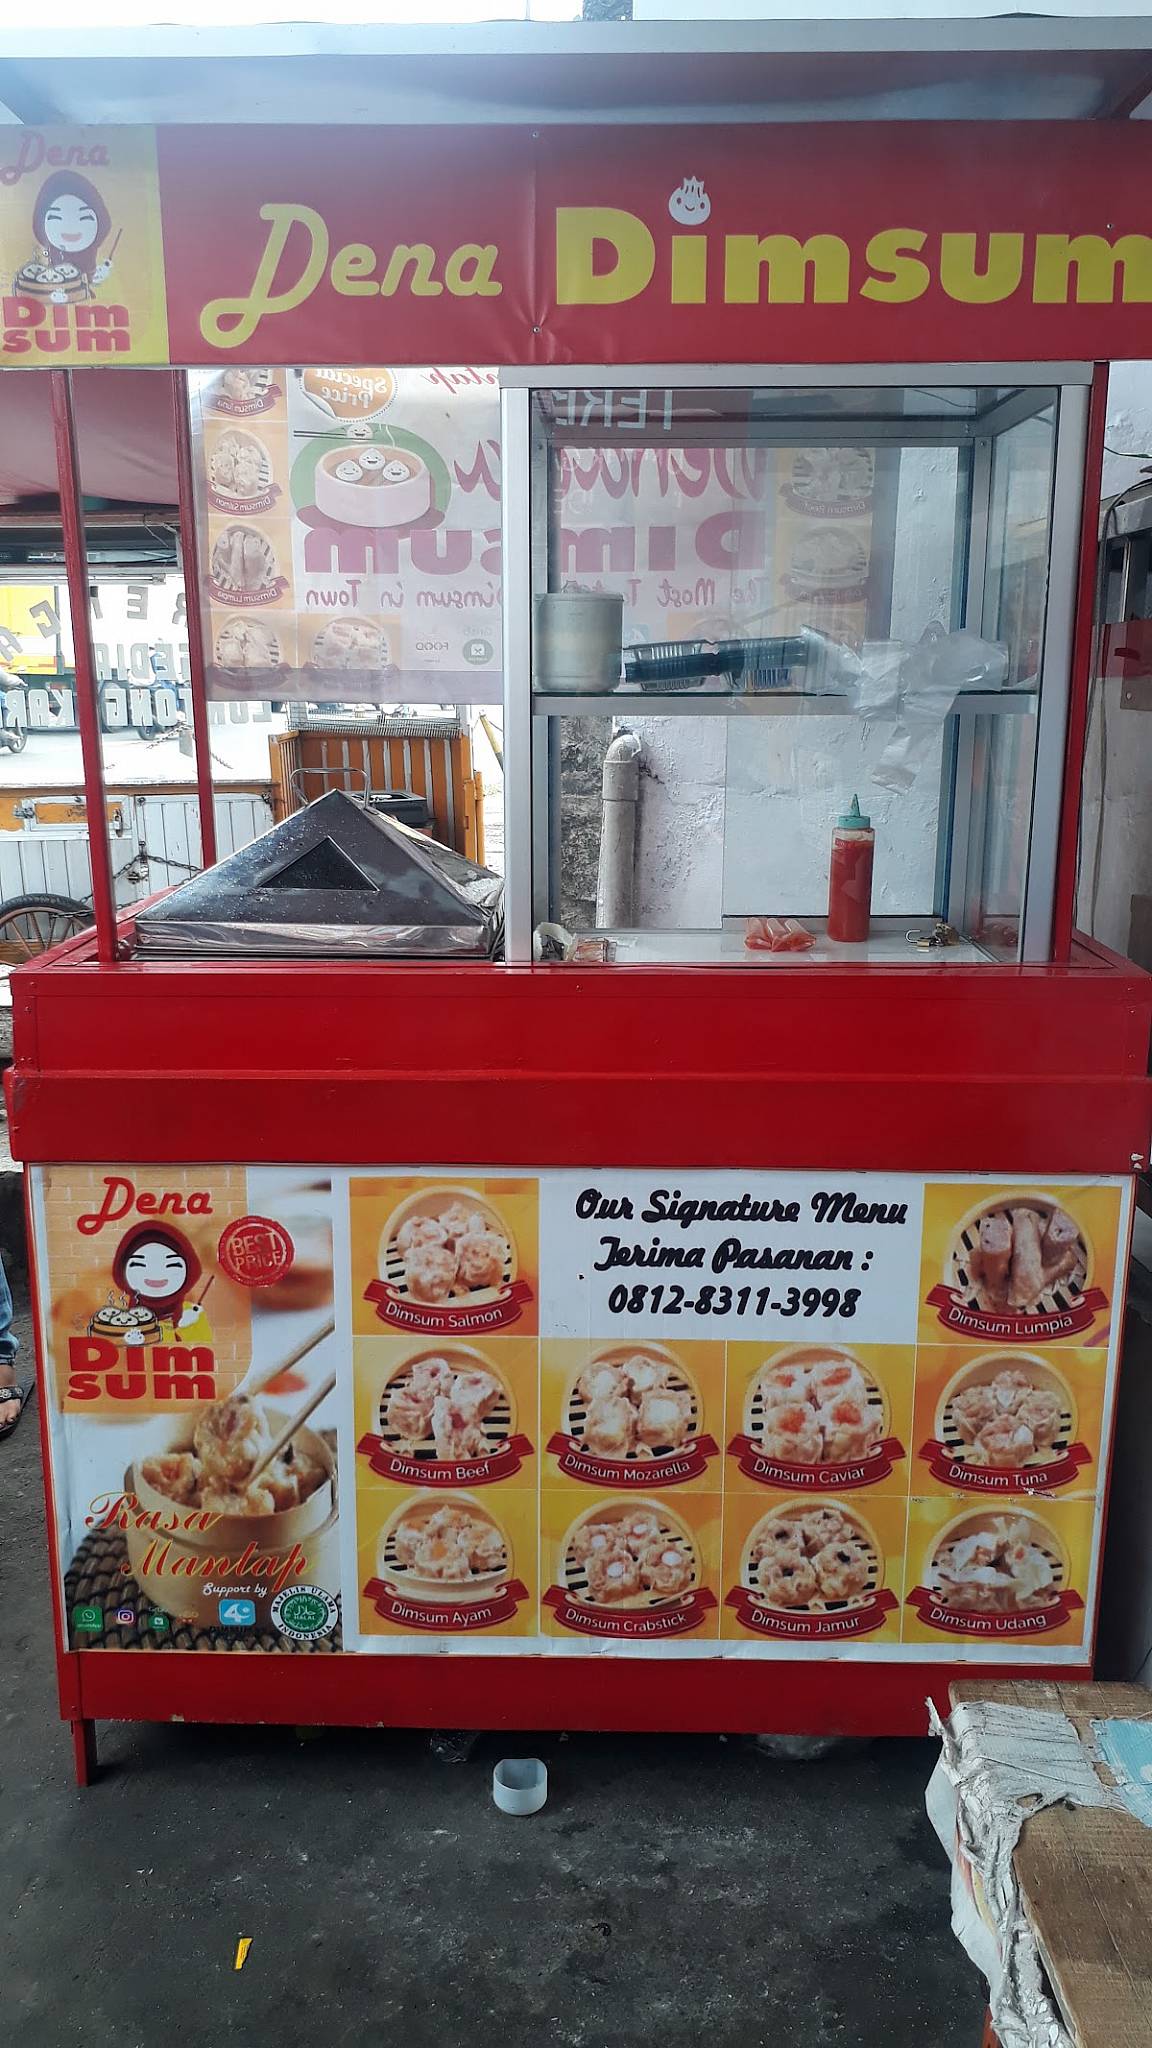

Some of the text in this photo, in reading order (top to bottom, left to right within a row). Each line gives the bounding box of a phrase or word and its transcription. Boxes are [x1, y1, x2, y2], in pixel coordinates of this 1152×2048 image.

[0, 131, 110, 186] Dena
[199, 203, 1152, 349] Dena Dimsum
[2, 298, 131, 327] Dim
[2, 328, 131, 353] sum
[77, 1177, 213, 1235] Dena
[575, 1188, 908, 1228] Our Signature Menu
[231, 1231, 277, 1257] BEST
[594, 1236, 706, 1271] Terima
[609, 1284, 862, 1317] 0812-8311-3998
[386, 1302, 503, 1328] Dimsum Salmon
[948, 1307, 1073, 1336] Dimsum Lumpia
[68, 1336, 214, 1372] Dim
[67, 1373, 216, 1400] sum
[389, 1459, 490, 1481] Dimsum Beef
[564, 1453, 690, 1481] Dimsum Mozarella
[753, 1458, 866, 1484] Dimsum Caviar
[949, 1464, 1048, 1487] Dimsum Tuna
[85, 1491, 222, 1532] Rasa
[120, 1539, 315, 1592] Mantap
[202, 1582, 267, 1598] Support by
[390, 1602, 492, 1626] Dimsum Ayam
[565, 1607, 687, 1632] Dimsum Crabstick
[752, 1609, 861, 1633] Dimsum Jamur
[930, 1607, 1047, 1630] Dimsum Udang
[278, 1623, 333, 1640] INDONESIA
